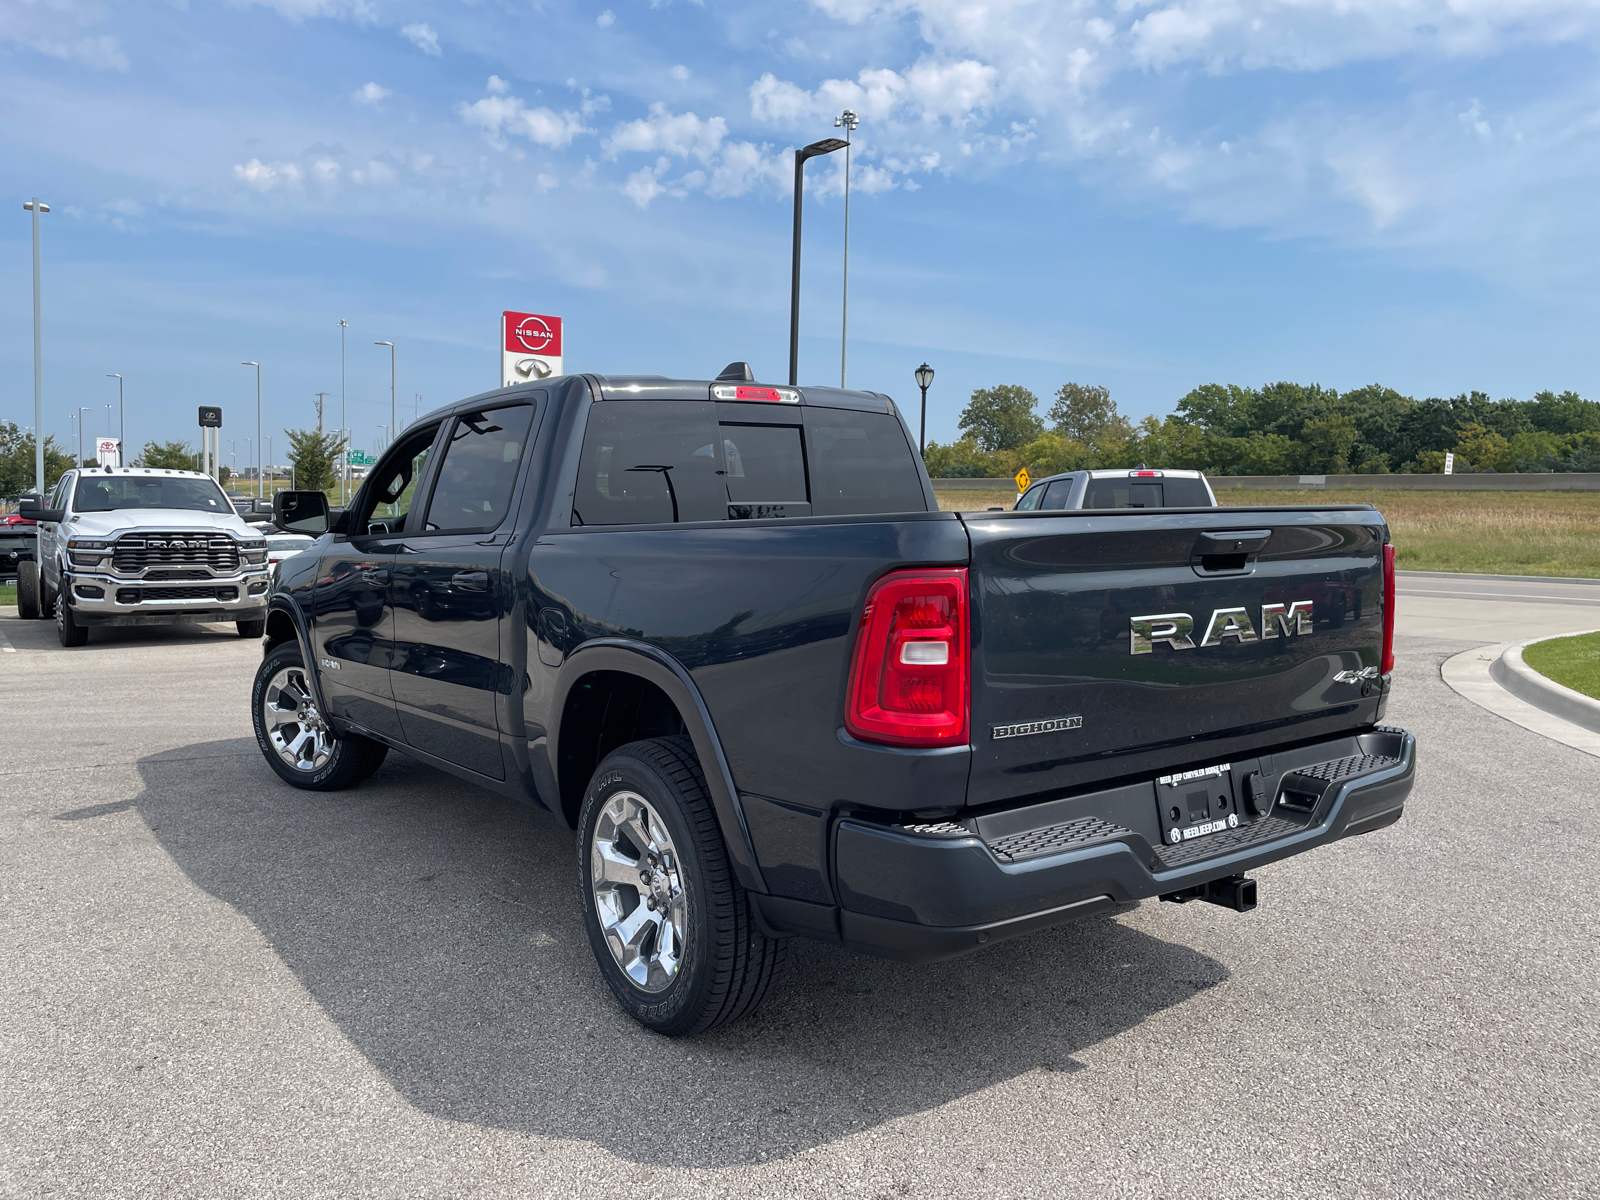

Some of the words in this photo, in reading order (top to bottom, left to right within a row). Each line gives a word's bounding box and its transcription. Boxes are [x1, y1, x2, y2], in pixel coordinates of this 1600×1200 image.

[515, 328, 553, 339] NISSAN
[147, 540, 208, 549] RAM
[1130, 600, 1313, 656] RAM
[993, 716, 1083, 739] BIGHORN
